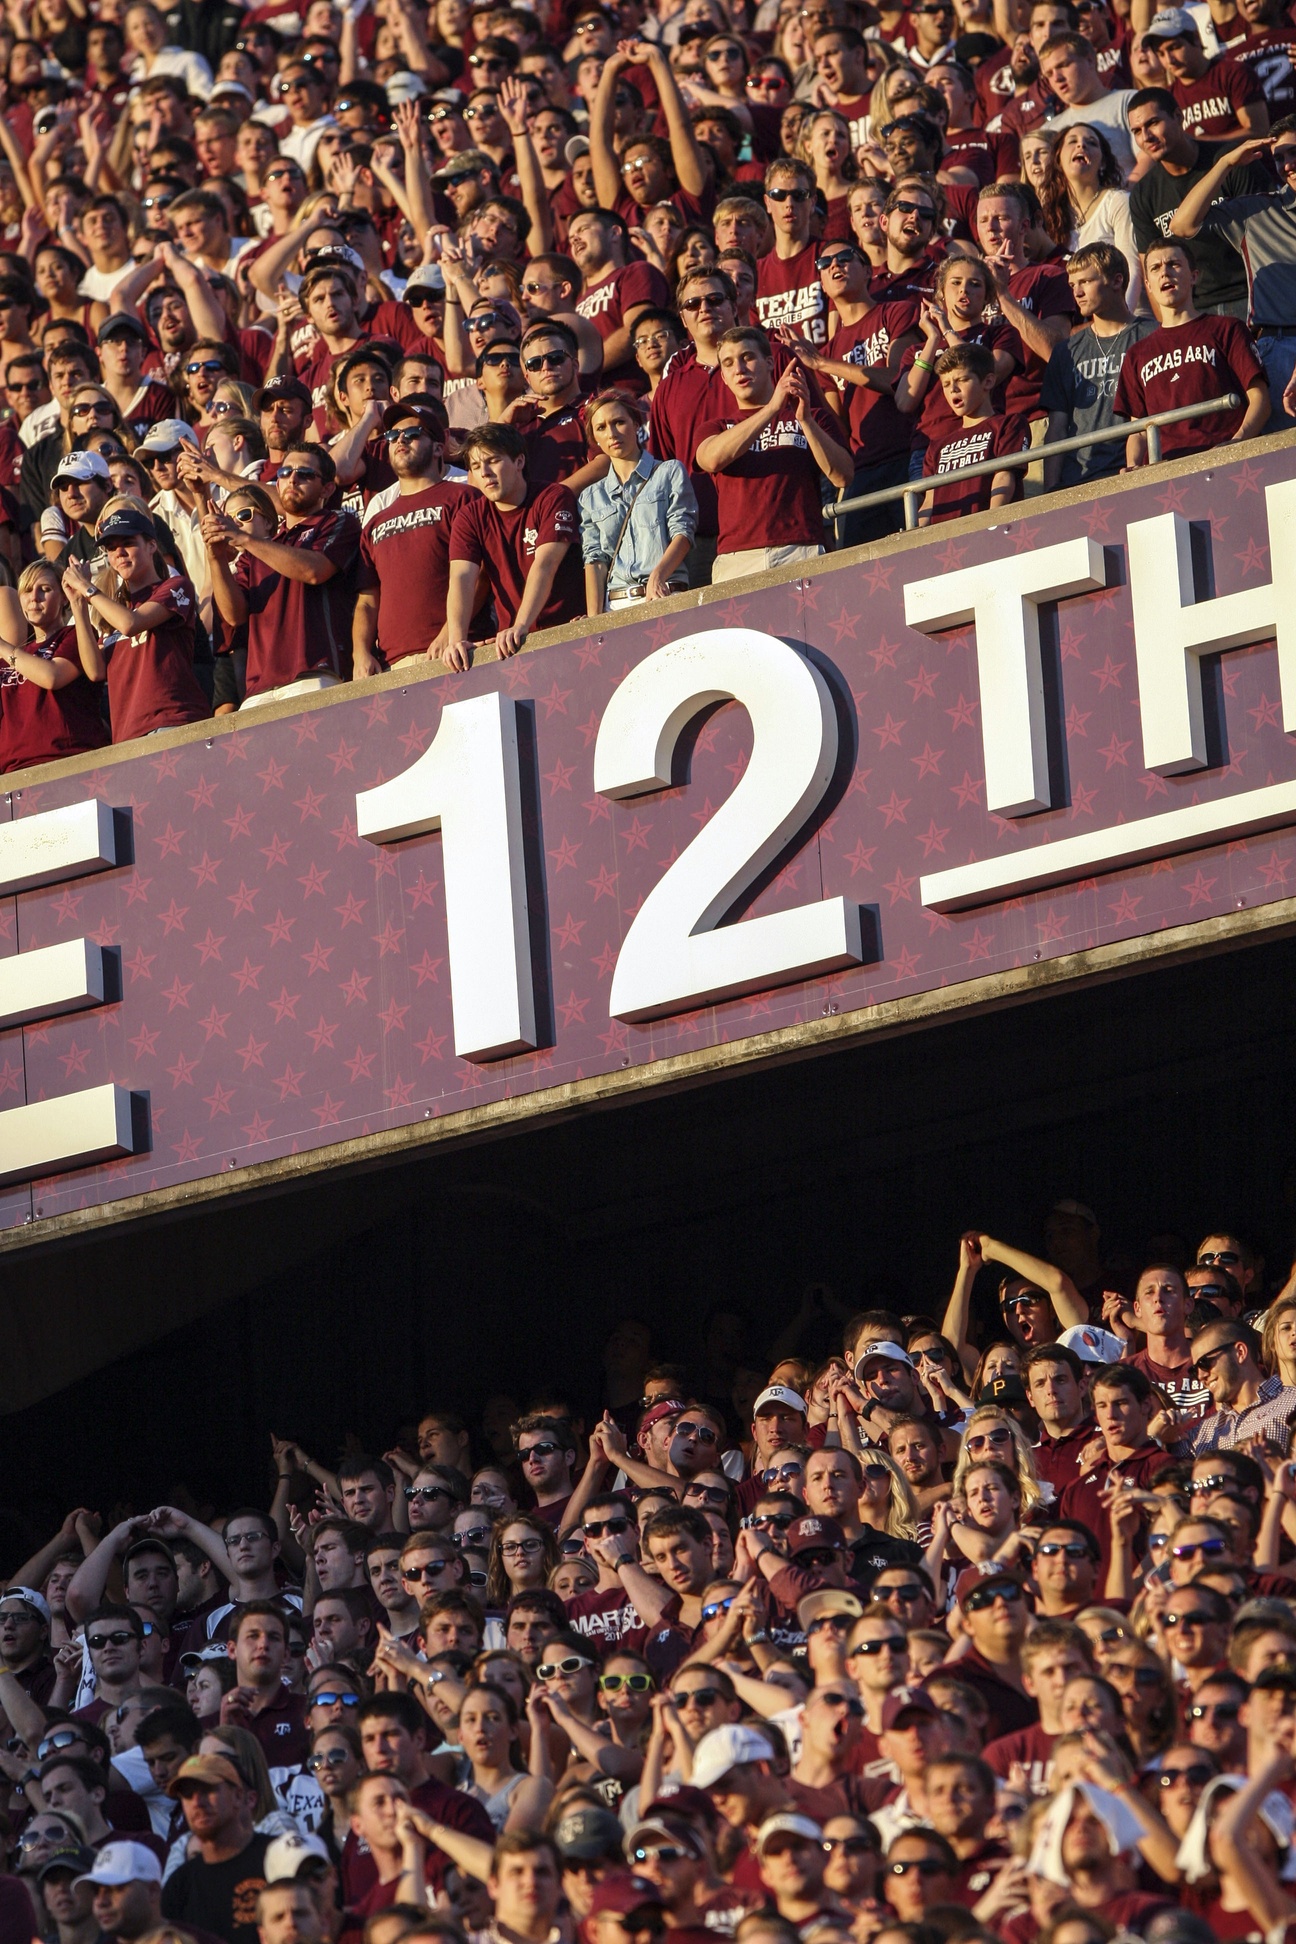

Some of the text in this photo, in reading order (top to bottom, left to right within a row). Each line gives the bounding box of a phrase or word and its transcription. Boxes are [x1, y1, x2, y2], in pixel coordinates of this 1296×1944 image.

[1203, 97, 1232, 119] A&M
[756, 281, 824, 320] TEXAS
[769, 313, 803, 329] AGGIES
[802, 319, 826, 344] 12
[843, 327, 889, 365] TEXAS
[1140, 345, 1216, 387] TEXAS A&M
[993, 1379, 1006, 1396] P
